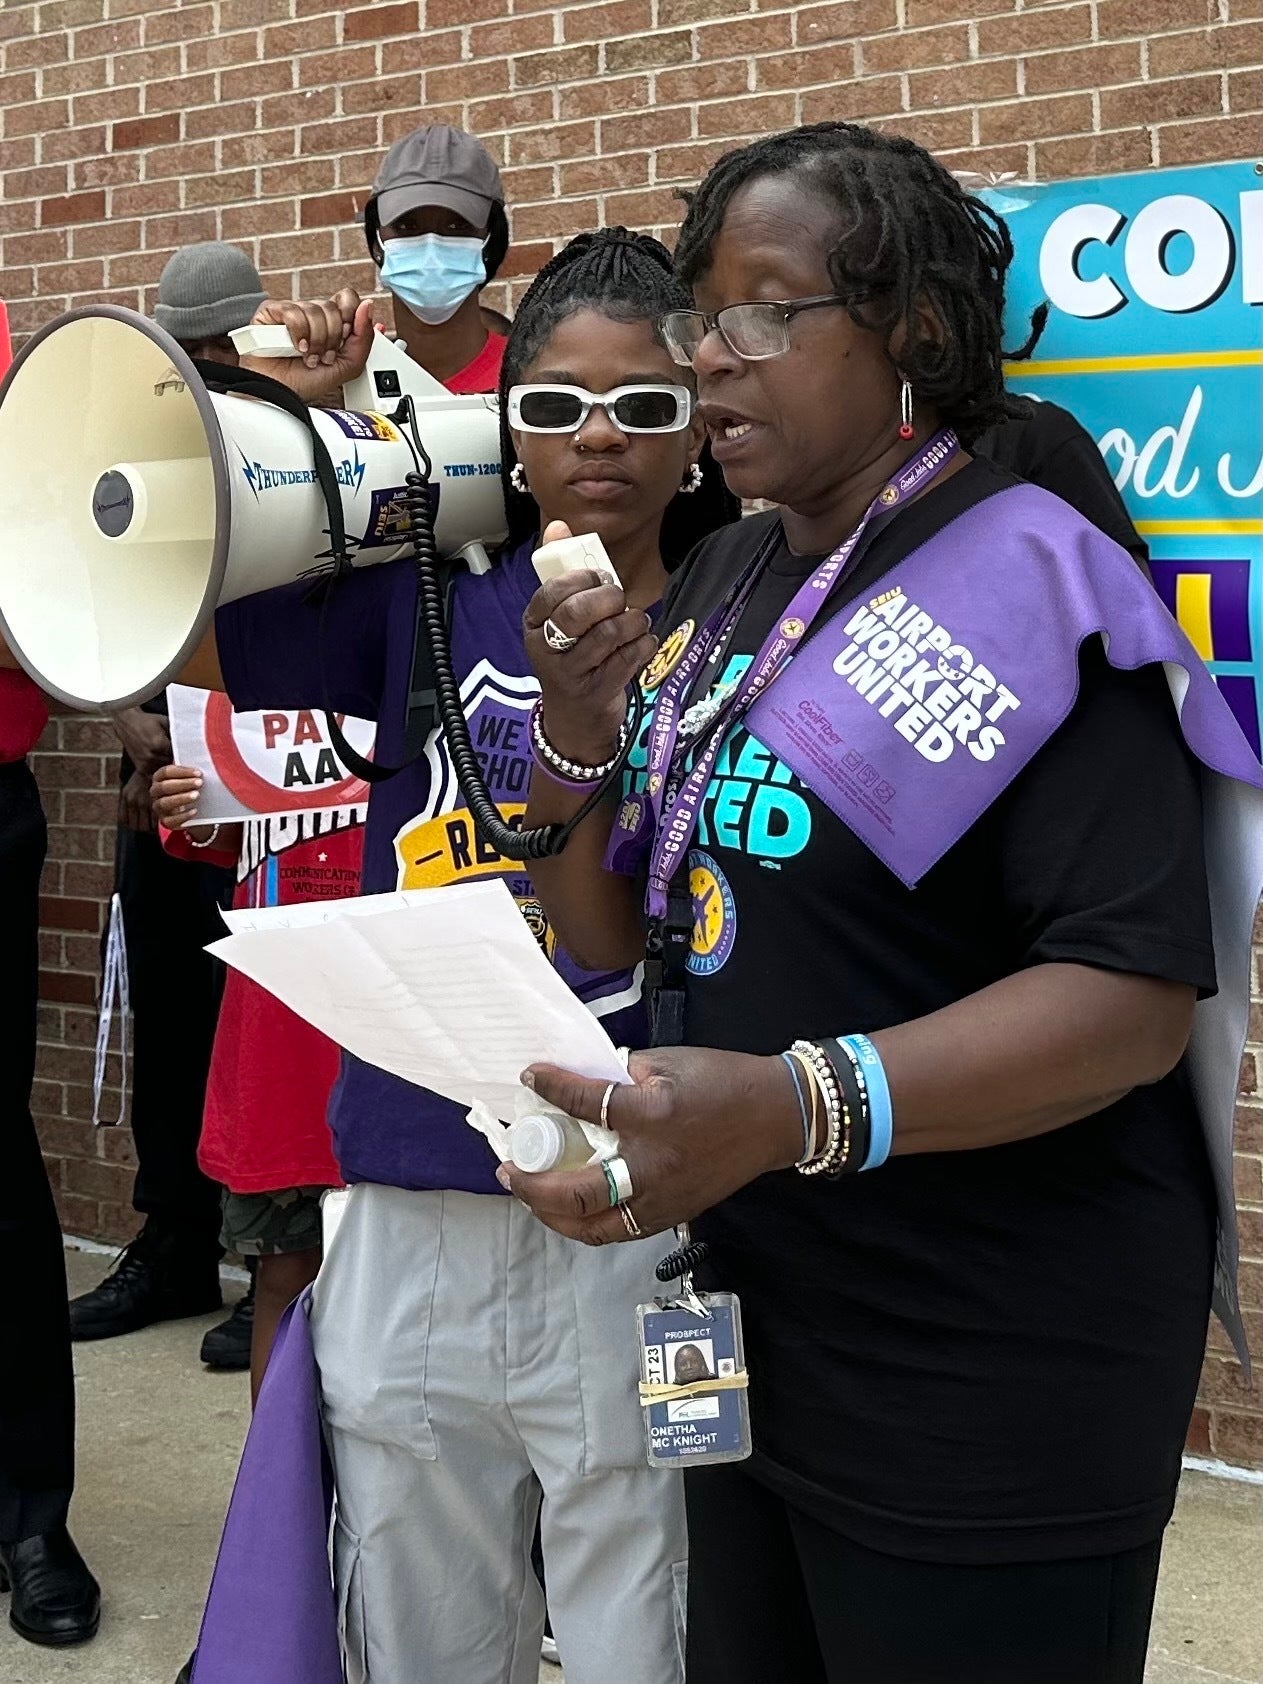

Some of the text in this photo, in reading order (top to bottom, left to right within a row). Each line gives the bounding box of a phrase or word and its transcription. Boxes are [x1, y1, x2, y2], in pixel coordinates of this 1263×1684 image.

[1039, 190, 1263, 320] CO
[922, 441, 949, 470] GOOD
[253, 459, 356, 492] THUNDERPER
[374, 505, 389, 537] SEIU
[869, 586, 902, 610] SEIU
[874, 593, 1021, 723] AIRPORT
[655, 696, 675, 732] GOOD
[666, 627, 711, 697] AIRPORTS
[843, 605, 1006, 762] WORKERS
[833, 642, 954, 763] UNITED
[477, 714, 524, 751] WE
[283, 747, 343, 788] AA
[474, 751, 533, 795] SHO
[664, 808, 692, 852] GOOD
[687, 953, 719, 970] NITED
[665, 1328, 711, 1340] PROSPECT
[648, 1347, 661, 1386] CT 23
[651, 1424, 697, 1437] ONETHA
[652, 1433, 717, 1448] MC KNIGHT
